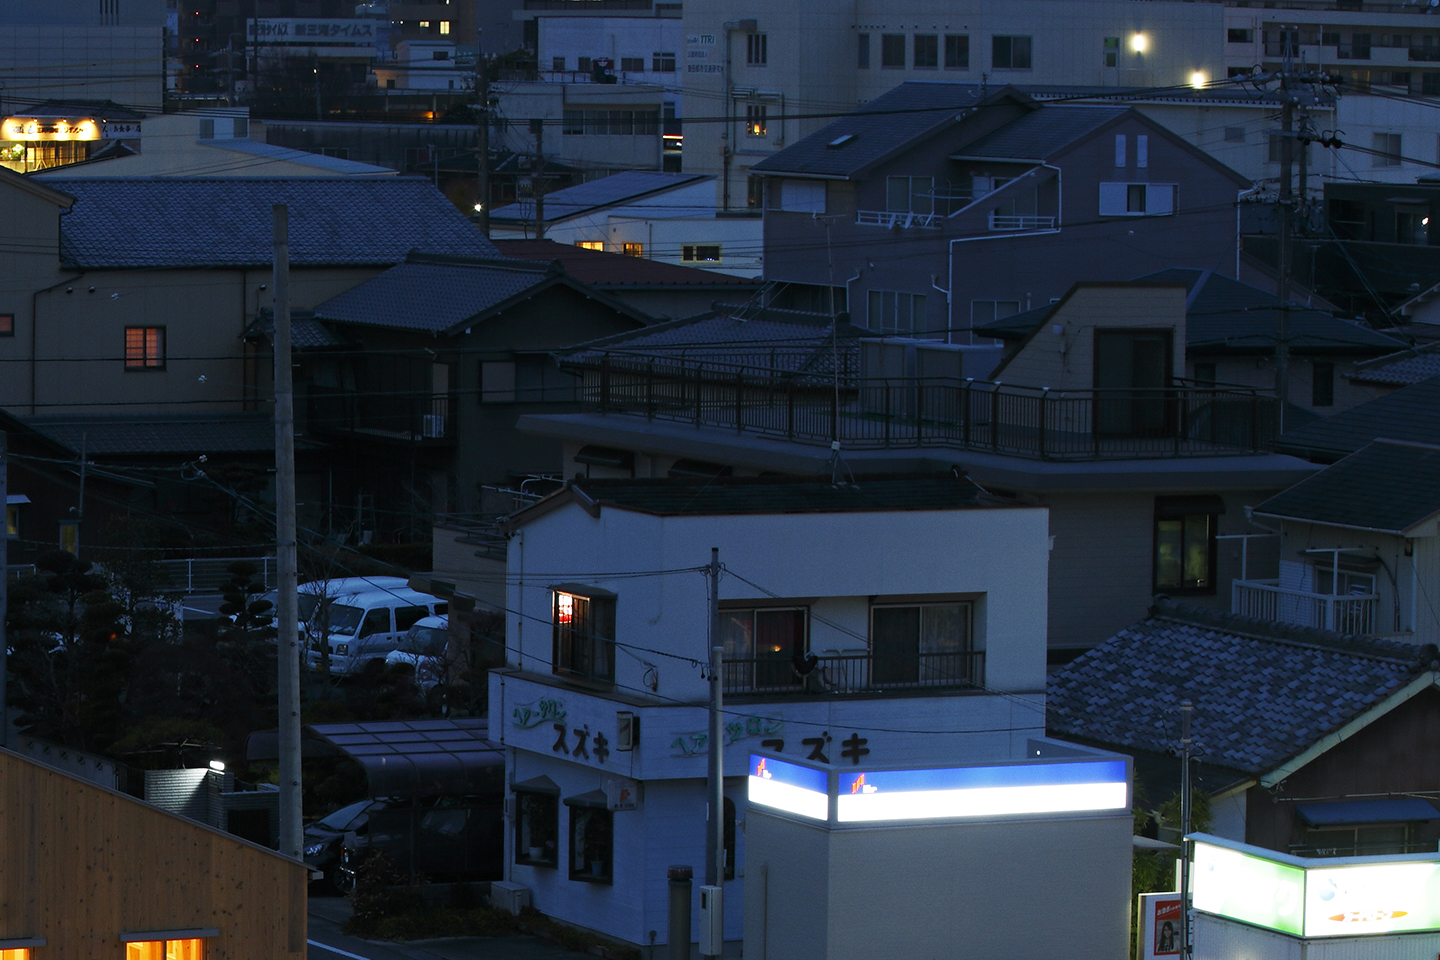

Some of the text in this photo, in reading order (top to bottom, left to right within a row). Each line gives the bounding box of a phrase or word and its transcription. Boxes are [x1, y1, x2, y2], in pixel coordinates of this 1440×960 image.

[552, 723, 609, 764] スズキ
[671, 716, 784, 754] ヘアサロン
